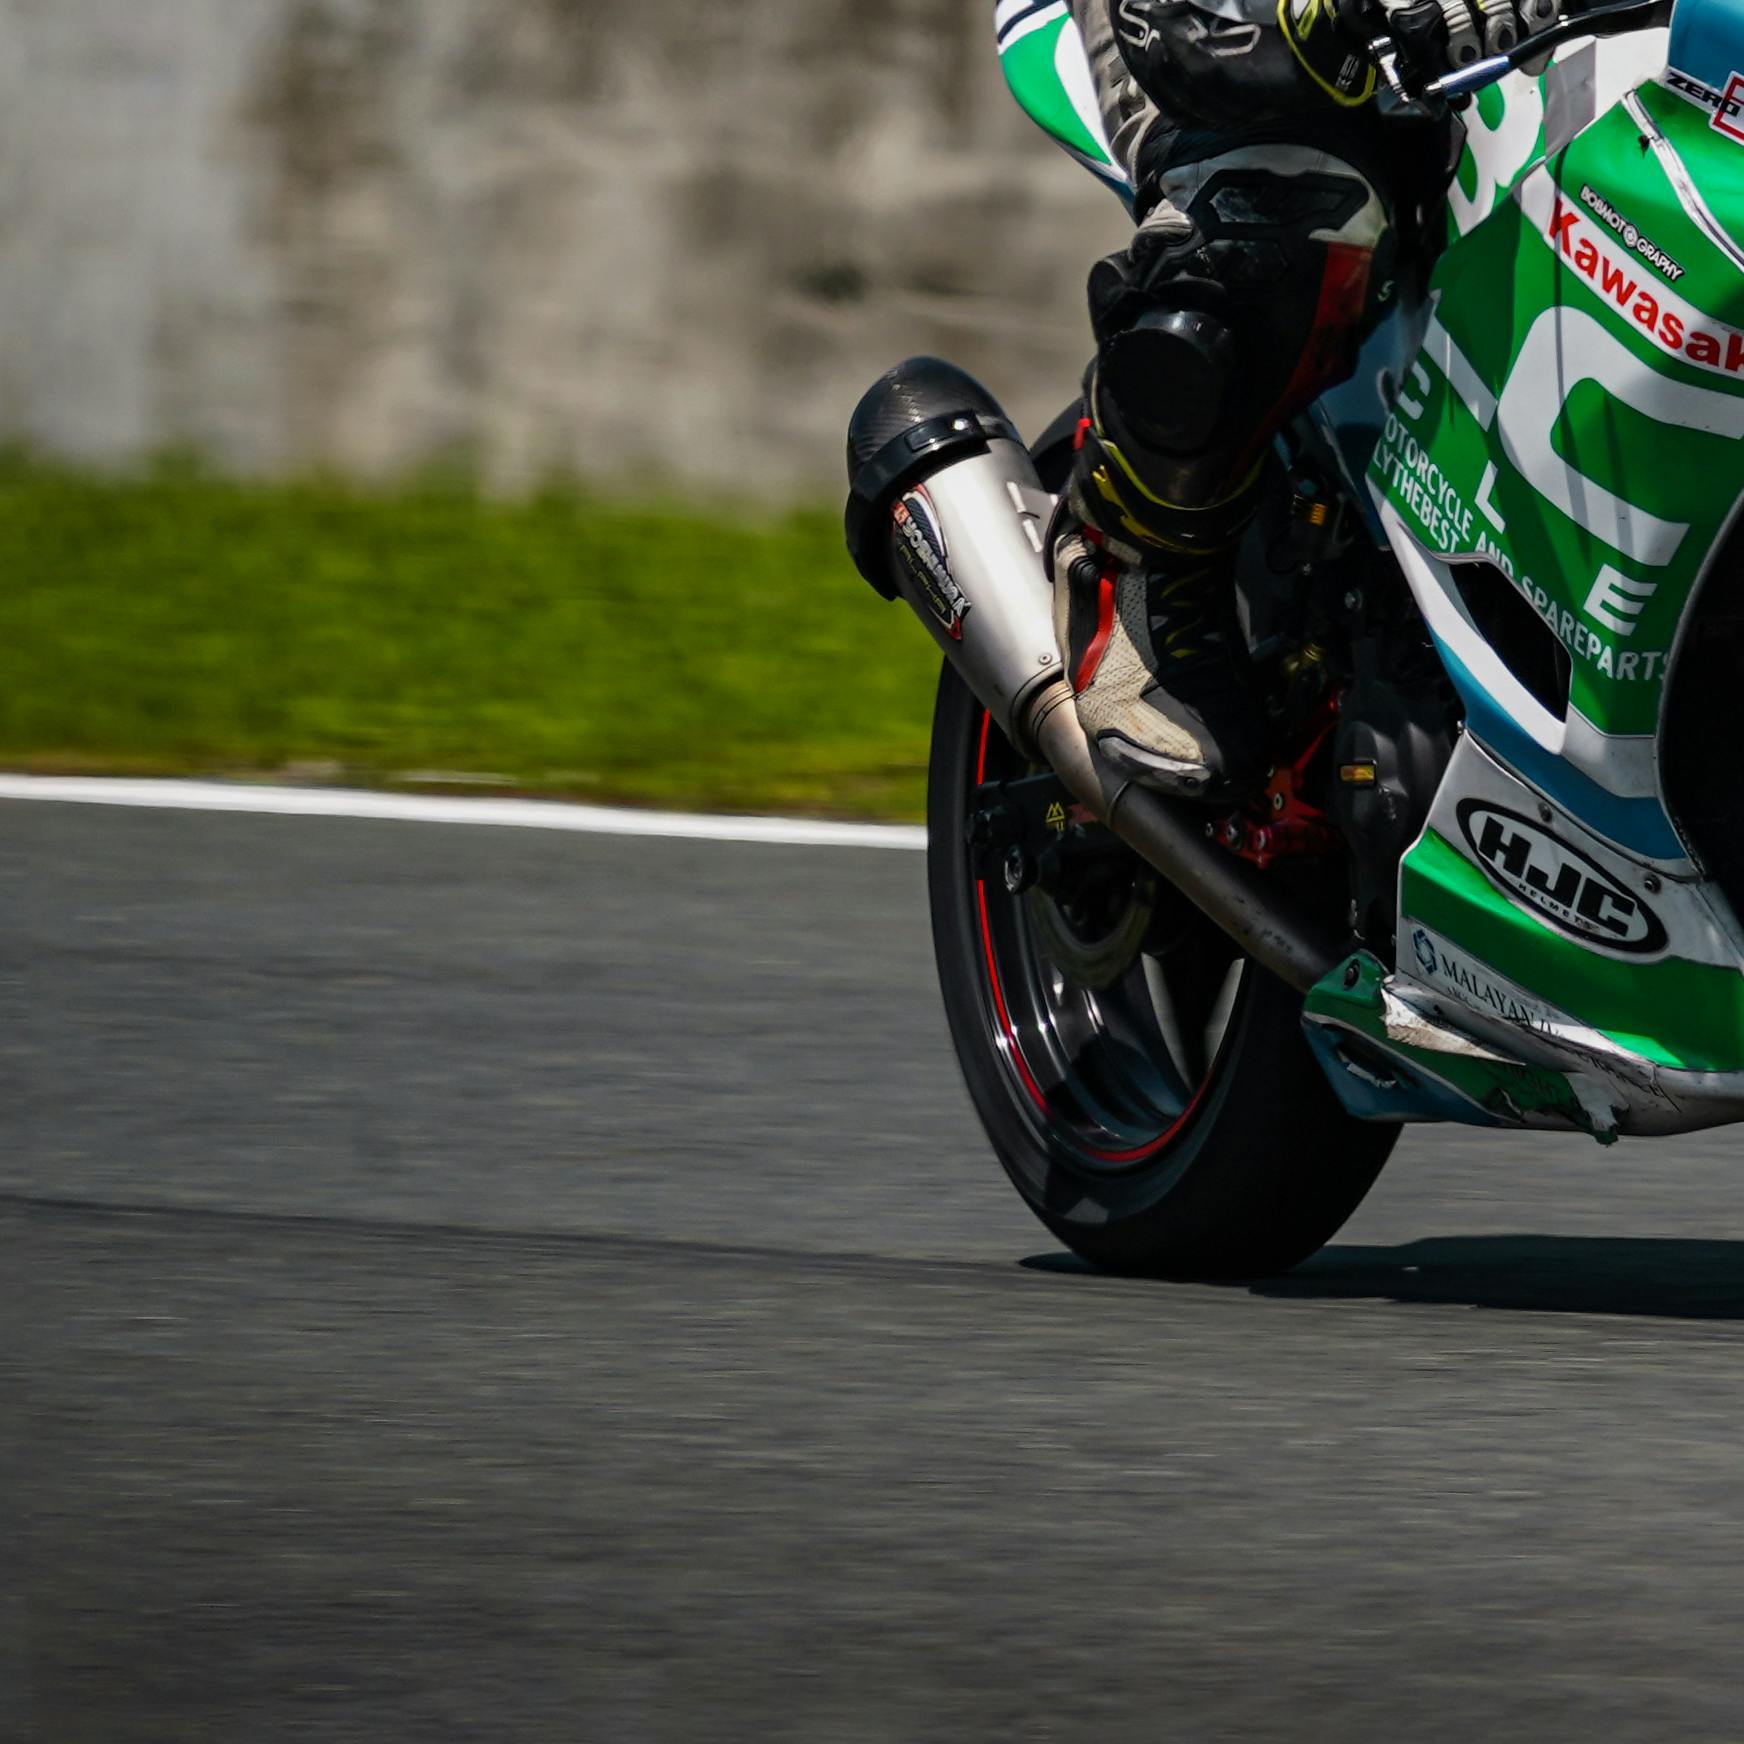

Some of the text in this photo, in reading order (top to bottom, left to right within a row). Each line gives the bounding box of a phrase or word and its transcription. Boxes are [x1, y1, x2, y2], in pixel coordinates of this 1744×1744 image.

[1665, 71, 1740, 117] ZERO
[1385, 414, 1474, 543] OTORCYCLE
[1477, 815, 1638, 938] HJC
